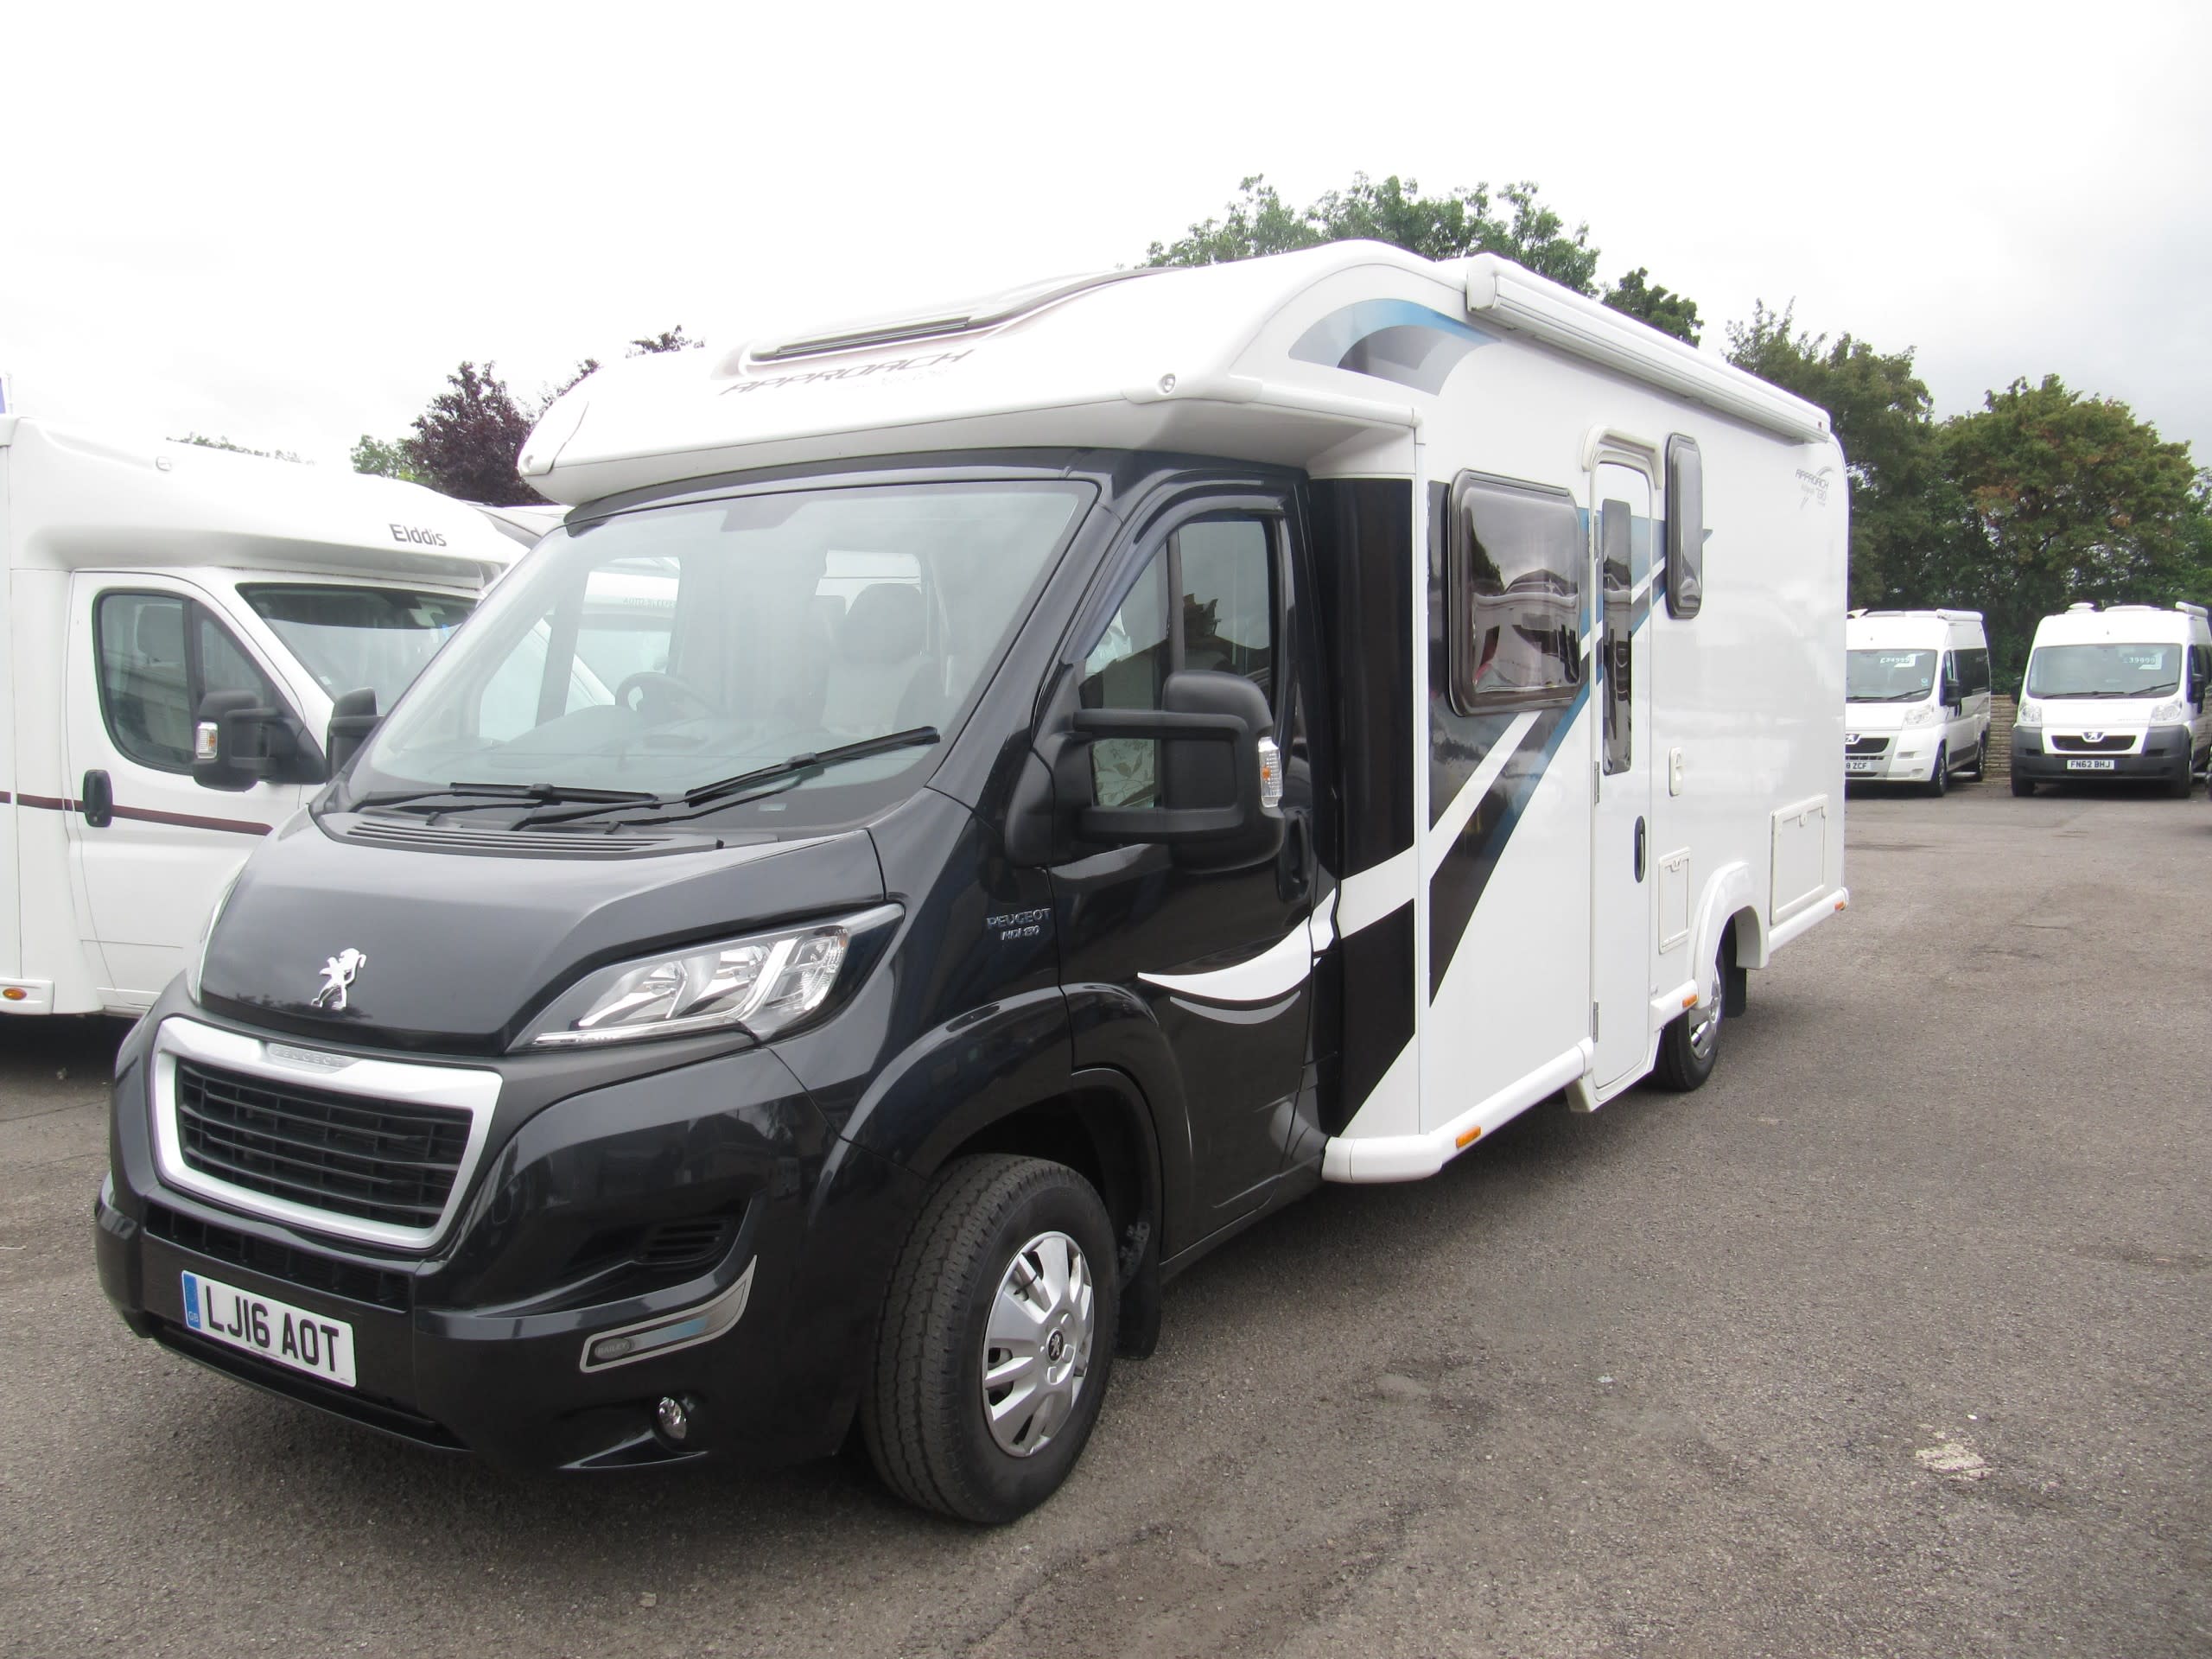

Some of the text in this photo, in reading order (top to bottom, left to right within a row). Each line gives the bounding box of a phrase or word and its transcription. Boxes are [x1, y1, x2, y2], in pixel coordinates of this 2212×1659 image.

[719, 349, 974, 396] APPROACH
[389, 524, 448, 547] Elddis
[986, 907, 1052, 929] PEUGEOT
[188, 1311, 200, 1323] GB
[206, 1285, 340, 1373] LJ16 AOT
